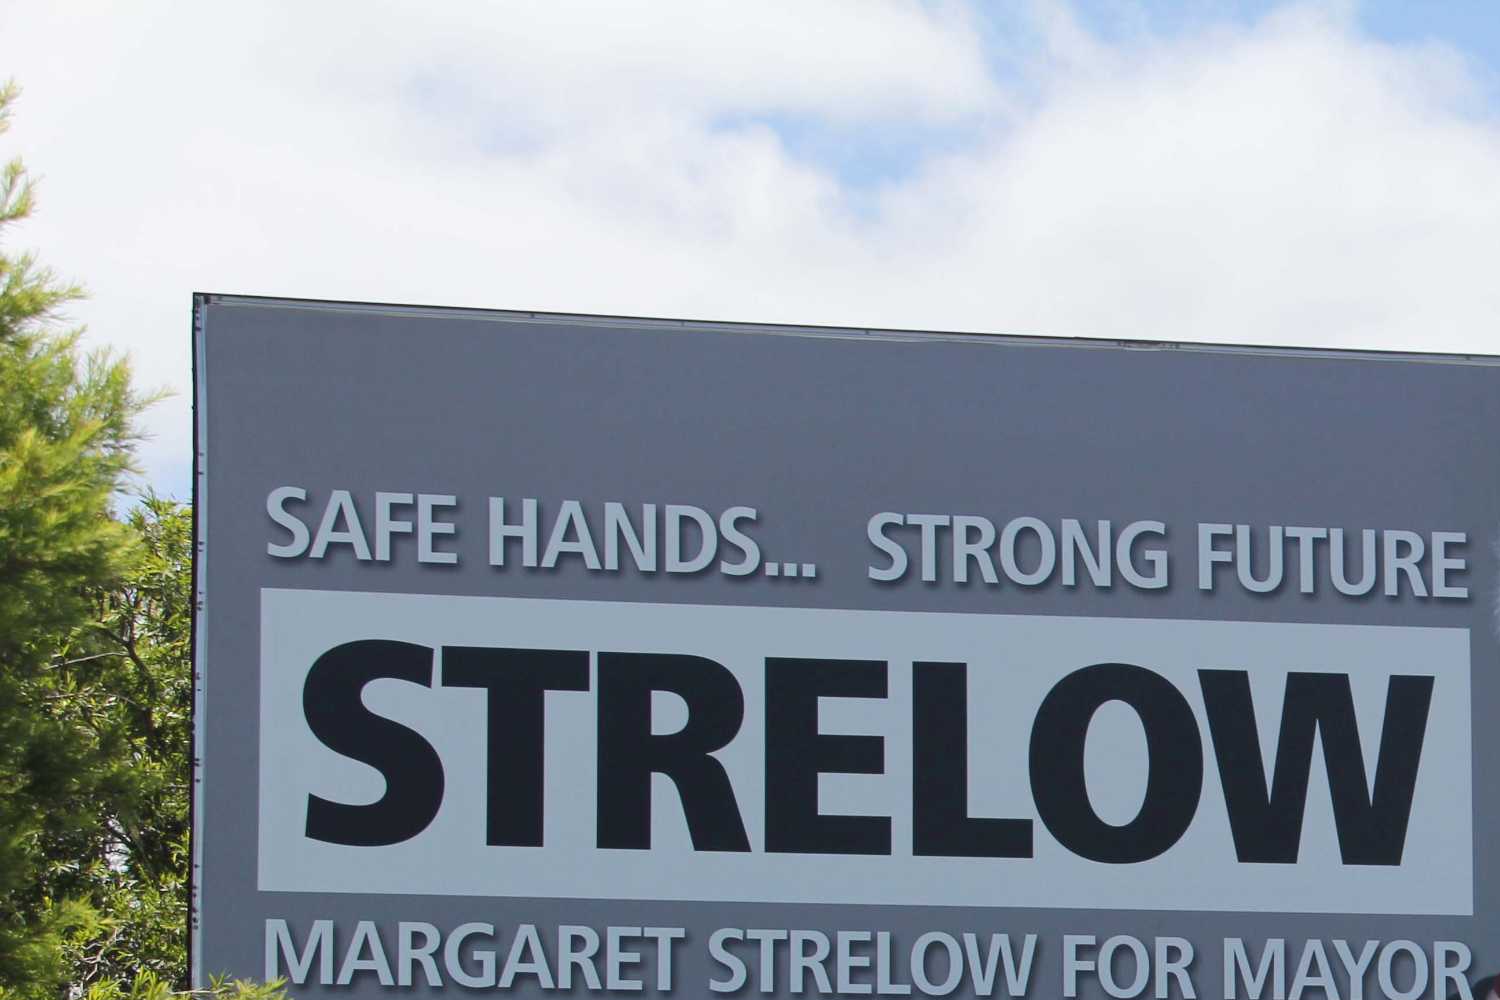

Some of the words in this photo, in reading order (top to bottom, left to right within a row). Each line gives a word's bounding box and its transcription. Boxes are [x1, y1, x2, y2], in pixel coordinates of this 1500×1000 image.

[265, 486, 458, 565] SAFE
[488, 496, 817, 578] HANDS...
[867, 511, 1169, 590] STRONG
[1198, 523, 1469, 600] FUTURE
[302, 639, 1435, 867] STRELOW
[264, 918, 685, 992] MARGARET
[708, 927, 1037, 998] STRELOW
[1063, 935, 1197, 1000] FOR
